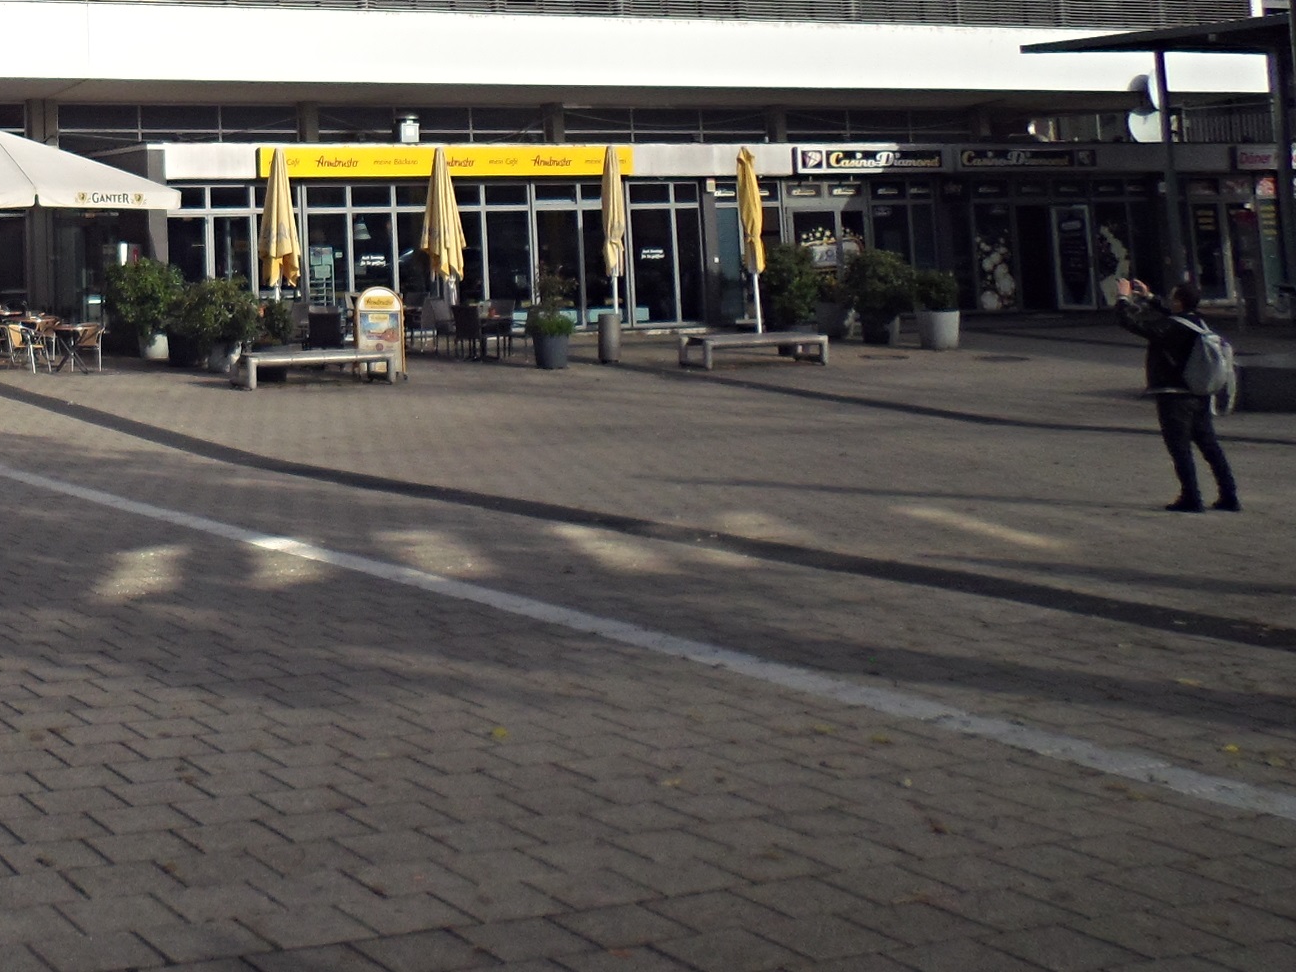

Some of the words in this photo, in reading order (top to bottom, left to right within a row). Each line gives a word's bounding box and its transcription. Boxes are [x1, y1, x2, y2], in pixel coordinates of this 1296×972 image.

[829, 151, 874, 168] Casino
[874, 151, 941, 168] Diamond
[91, 192, 130, 204] GANTER
